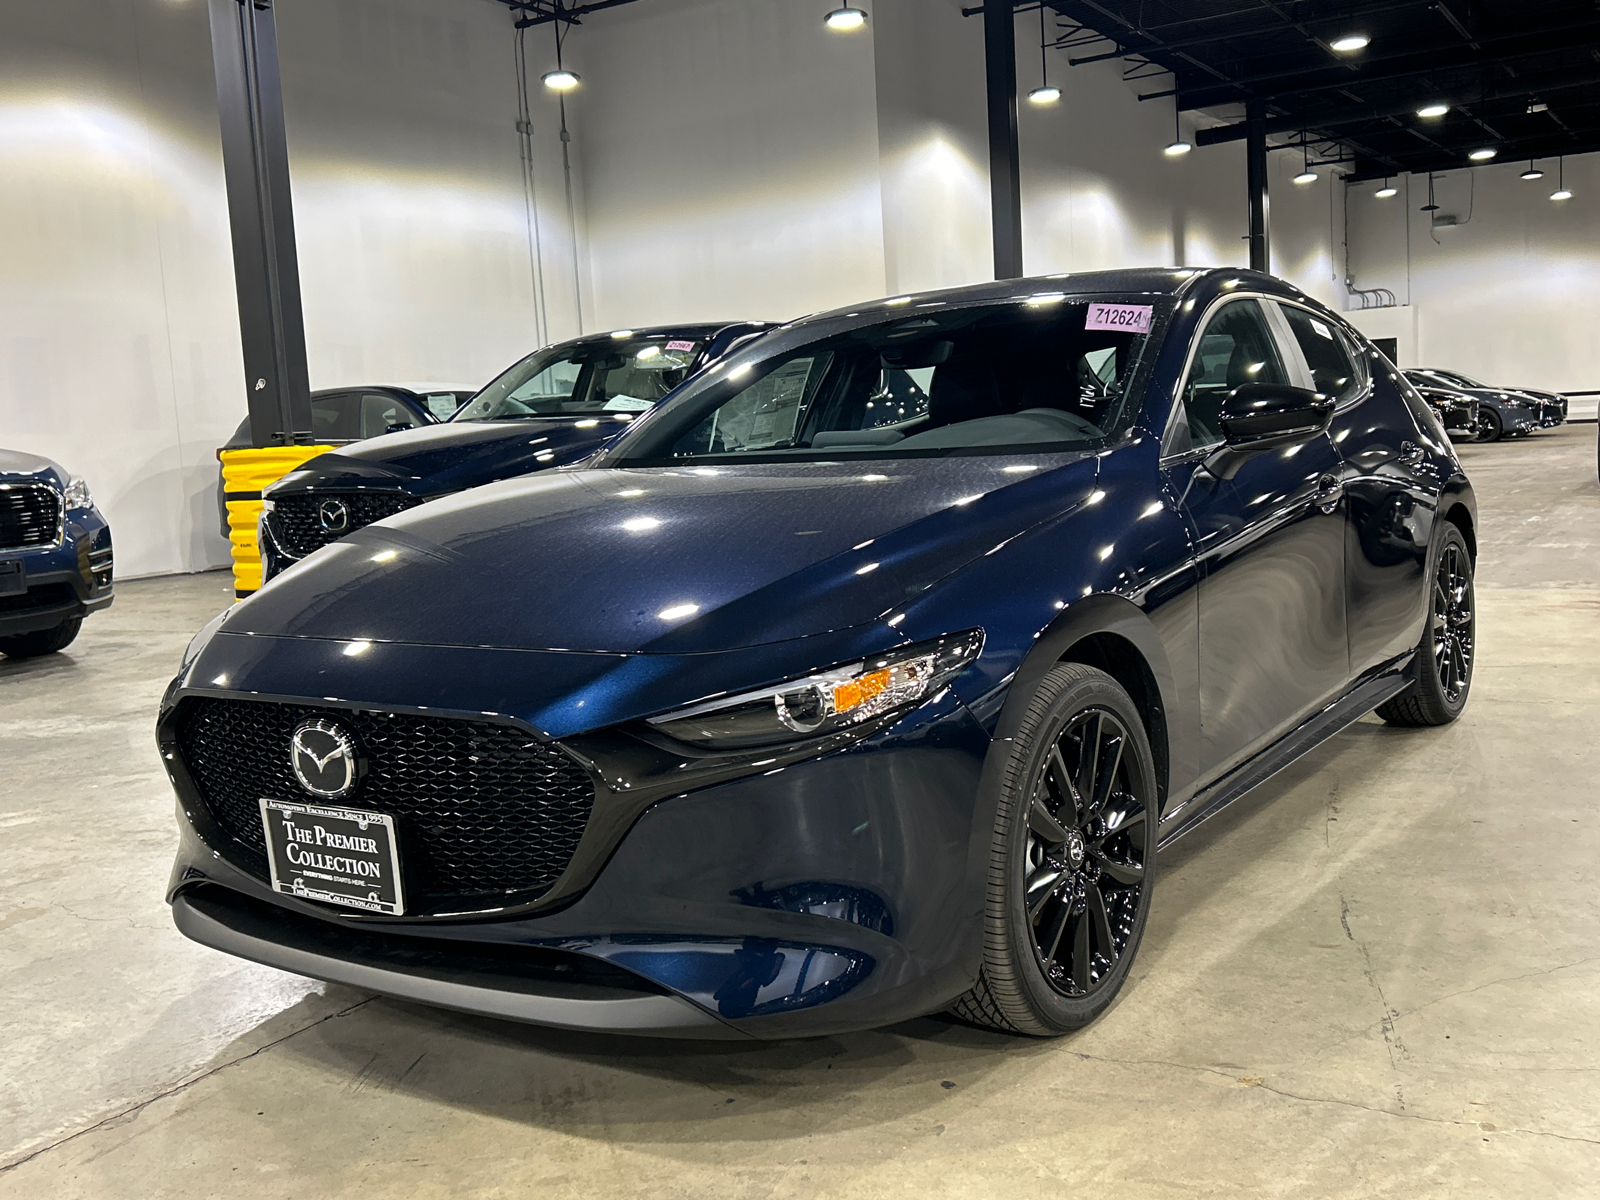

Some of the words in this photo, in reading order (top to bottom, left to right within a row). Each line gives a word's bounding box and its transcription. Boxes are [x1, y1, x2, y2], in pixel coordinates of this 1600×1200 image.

[1095, 308, 1142, 327] Z12624
[364, 814, 383, 824] 1995
[282, 820, 314, 844] THE
[314, 825, 379, 854] PREMIER
[286, 843, 381, 879] COLLECTION
